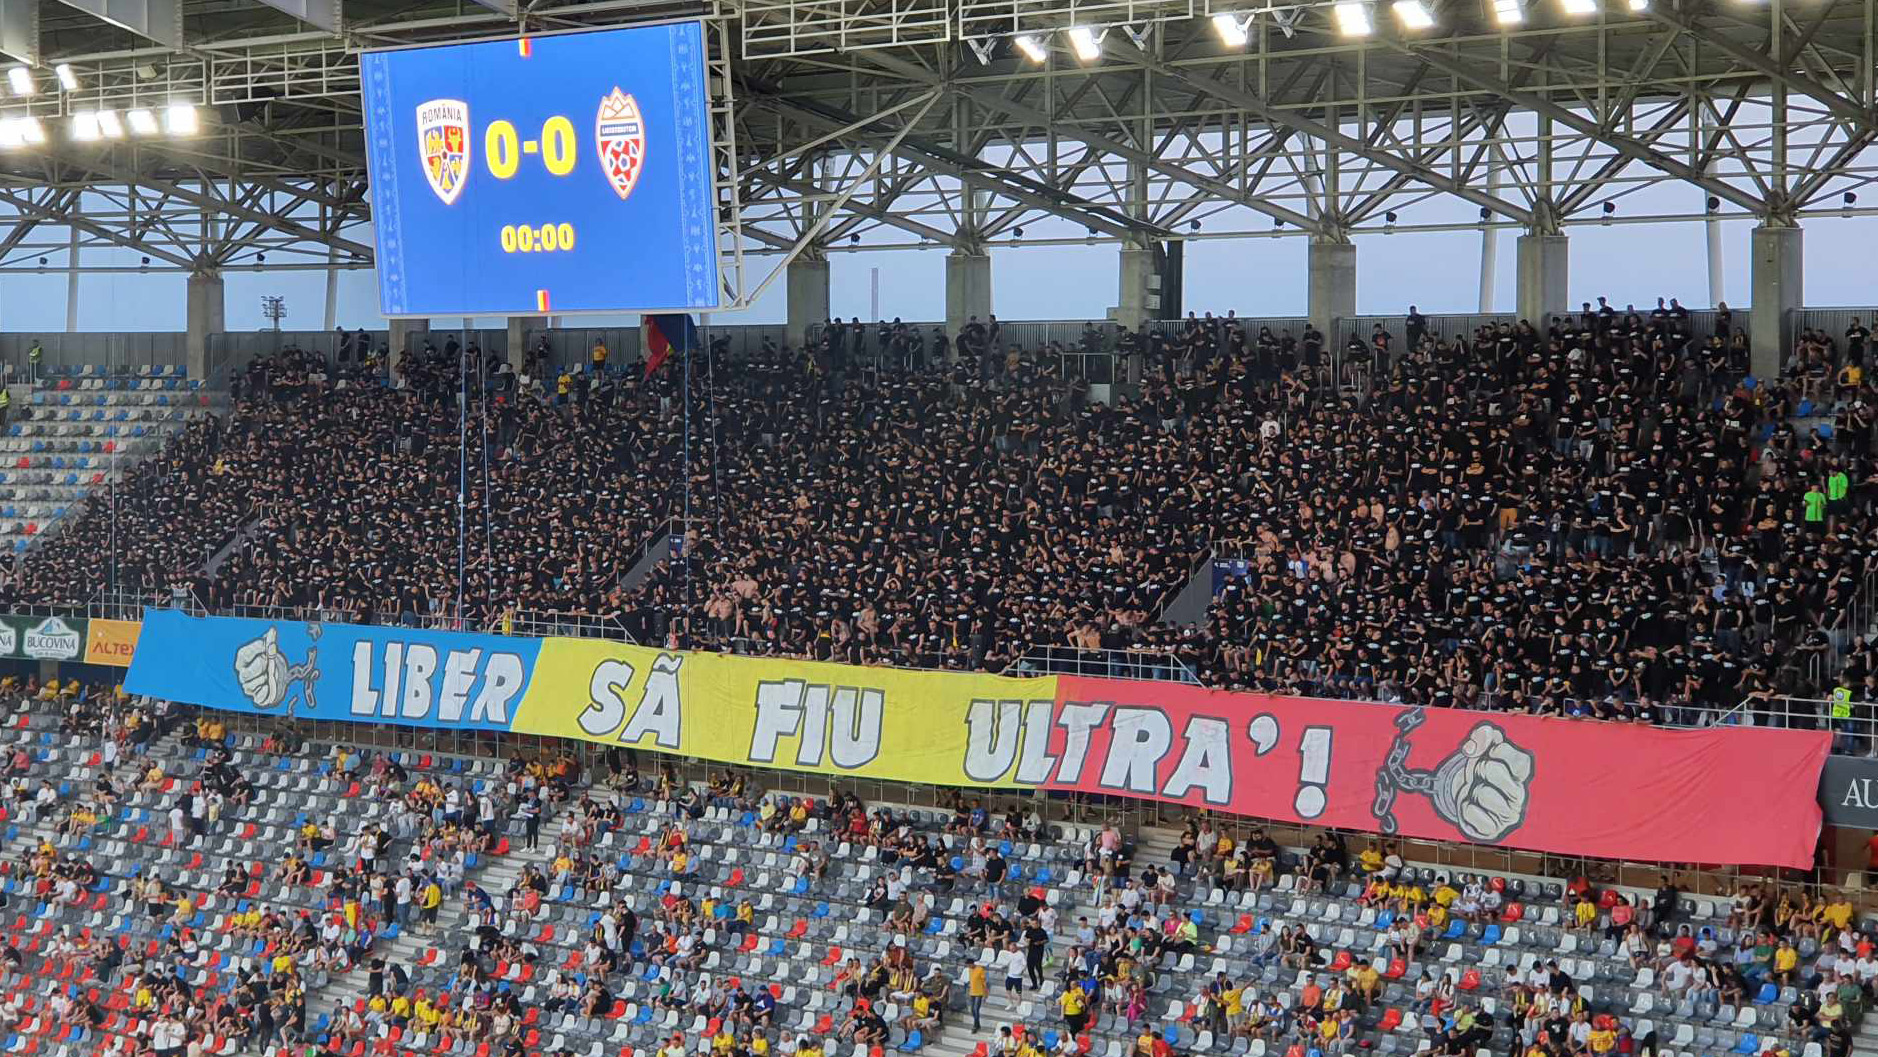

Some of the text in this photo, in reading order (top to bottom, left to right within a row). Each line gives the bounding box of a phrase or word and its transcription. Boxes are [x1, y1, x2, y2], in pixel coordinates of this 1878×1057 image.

[484, 115, 577, 179] 0-0
[500, 222, 574, 253] 00:00
[27, 635, 76, 650] BUCOVINA
[350, 640, 525, 724] LIBER
[747, 677, 886, 769] FIU
